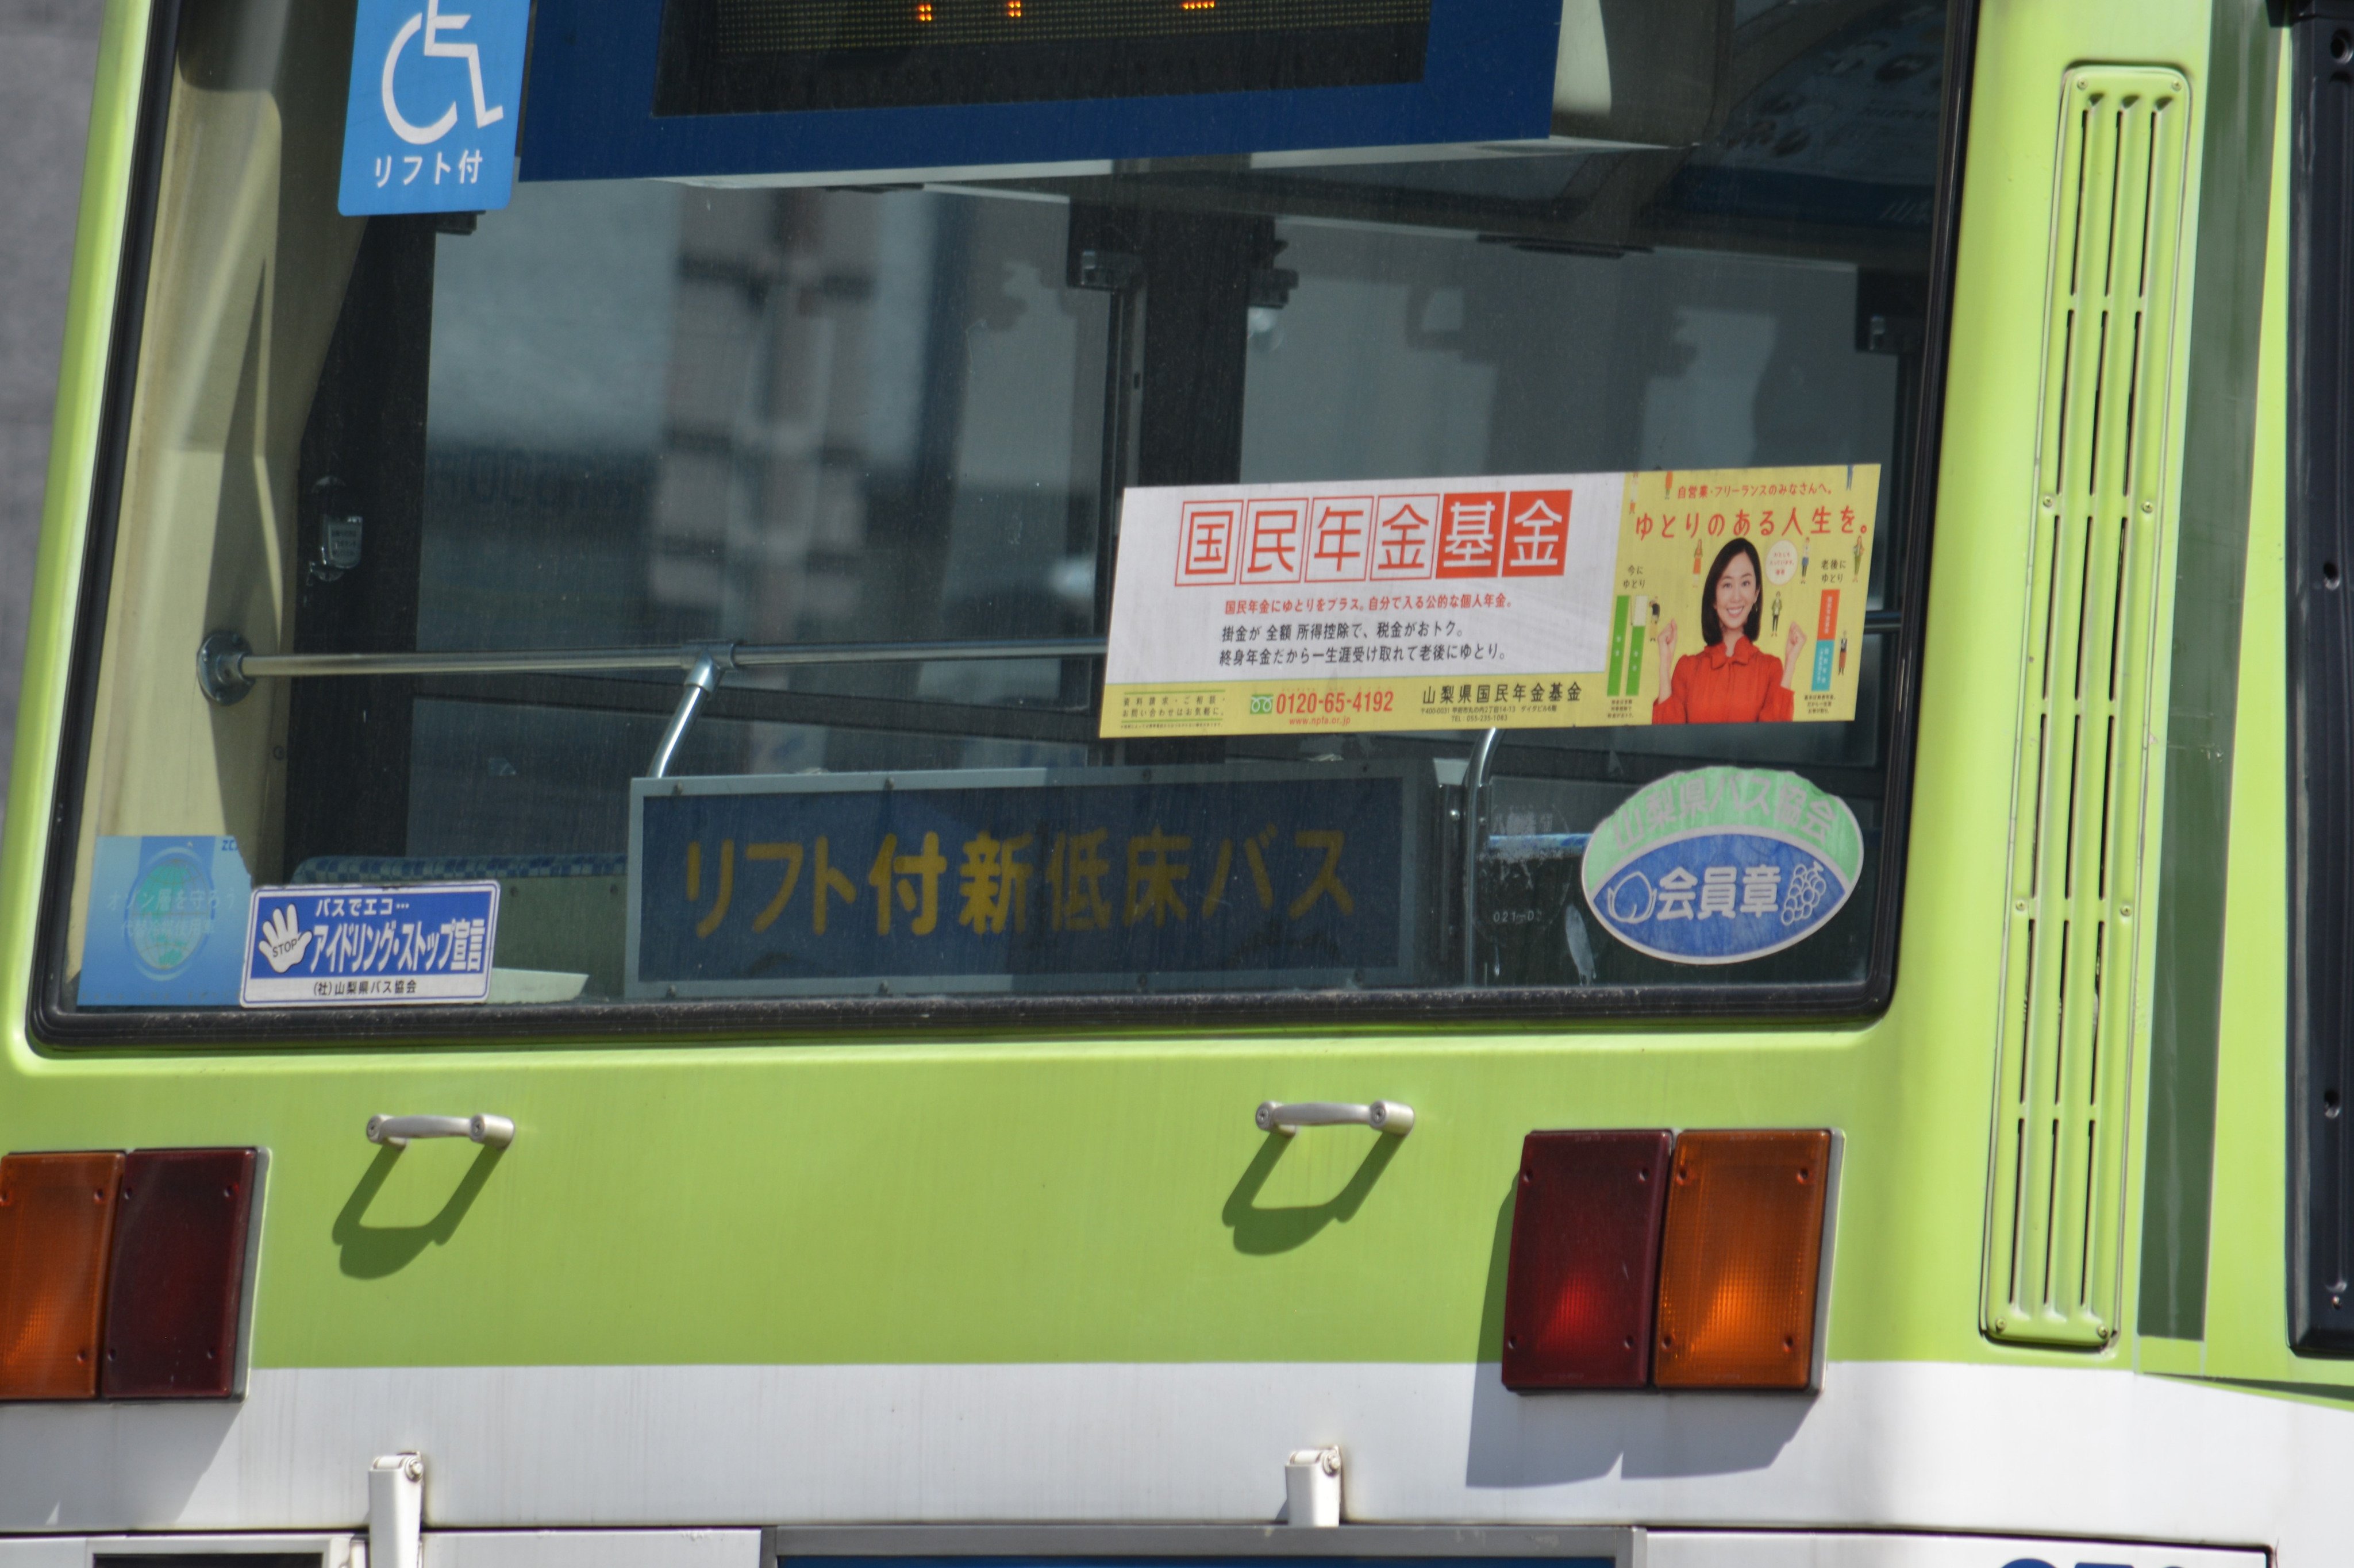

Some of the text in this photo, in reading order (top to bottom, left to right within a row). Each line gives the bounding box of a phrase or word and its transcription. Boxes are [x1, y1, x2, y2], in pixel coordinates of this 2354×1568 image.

[375, 149, 483, 188] リフト付
[1677, 483, 1832, 499] 自営業・フリーランスのみなさんへ。
[1636, 505, 1868, 541] ゆとりのある人生を。
[1184, 498, 1565, 575] 国民年金基金
[1628, 565, 1644, 575] 今に
[1821, 558, 1847, 569] 老後に
[1623, 579, 1646, 589] ゆとり
[1822, 573, 1843, 583] ゆとり
[1220, 643, 1505, 667] 終身年金だから一生涯受け取れて老後にゆとり。
[1276, 691, 1394, 715] 0120-65-4192
[1422, 681, 1582, 704] 山梨県国民年金基金
[1288, 715, 1351, 726] www.npfa.or.jp
[1611, 772, 1838, 852] 山梨県バス協会
[683, 824, 1356, 938] リフト付新低床バス
[1656, 864, 1782, 920] 会員章
[272, 938, 297, 958] STOP
[310, 918, 486, 974] アイドリング・ストップ宣言
[313, 980, 417, 996] (社)山梨県バス協会
